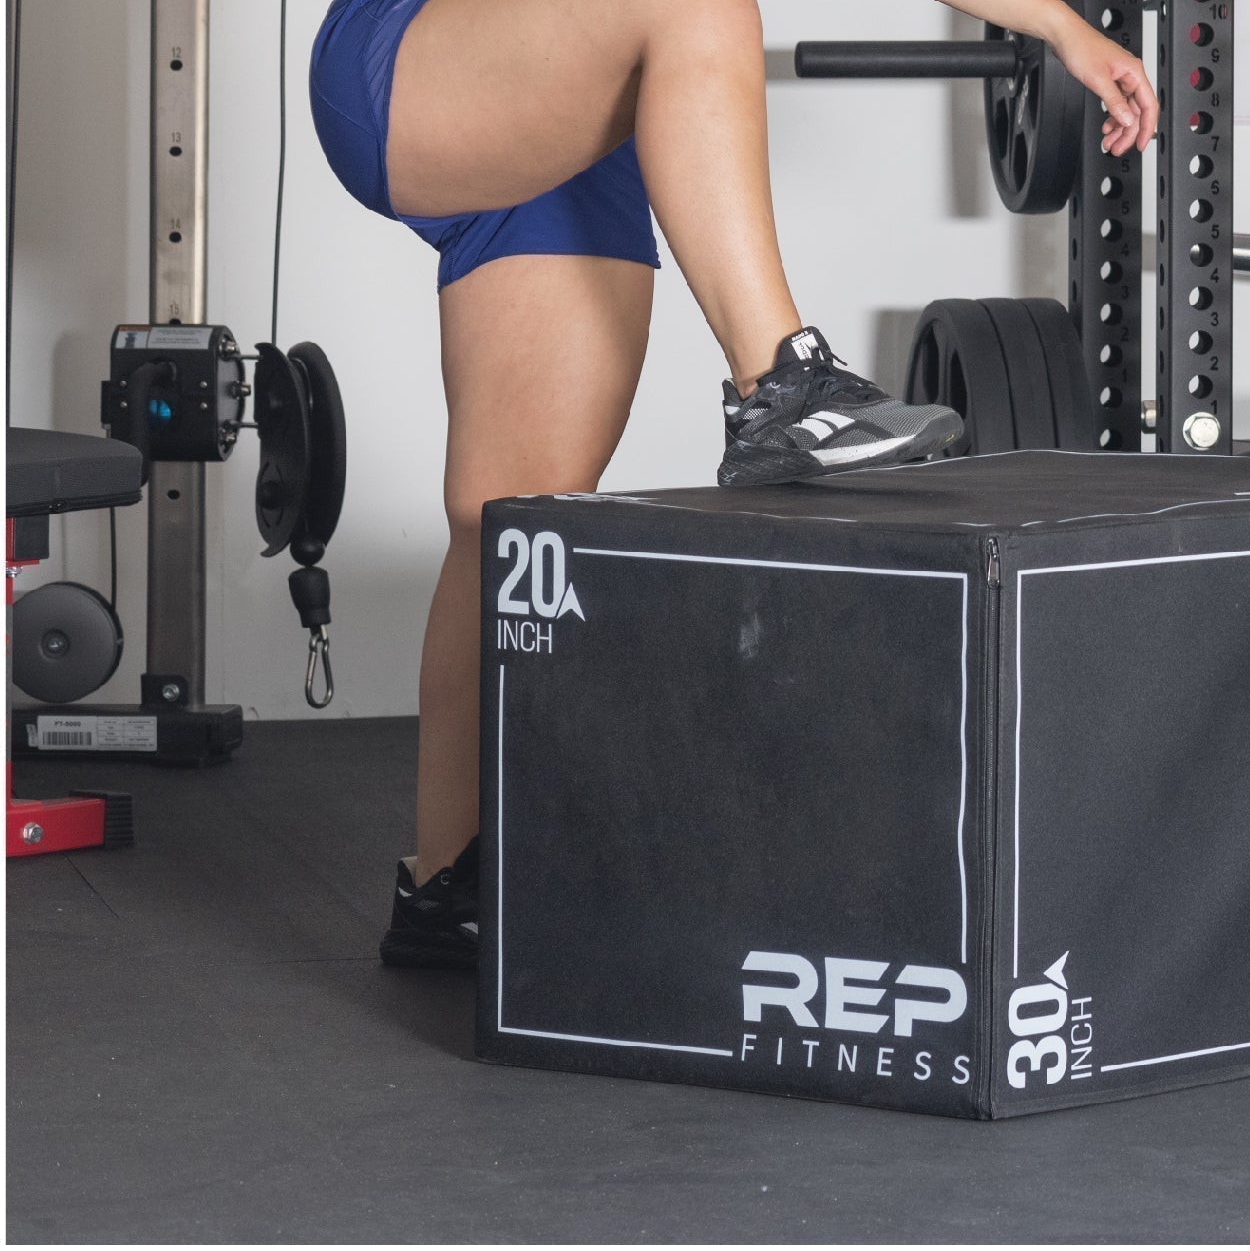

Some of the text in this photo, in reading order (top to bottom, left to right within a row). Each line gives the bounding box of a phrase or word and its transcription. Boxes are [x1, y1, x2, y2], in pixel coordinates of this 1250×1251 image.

[1210, 4, 1227, 19] 10
[172, 47, 181, 58] 12
[1211, 92, 1219, 107] 8
[172, 133, 181, 143] 13
[1211, 136, 1219, 151] 7
[171, 220, 181, 230] 14
[1211, 224, 1219, 239] 5
[1210, 268, 1219, 283] 4
[1211, 312, 1218, 327] 3
[1210, 356, 1218, 371] 2
[1211, 400, 1217, 414] 1
[498, 528, 565, 617] 20
[498, 619, 552, 653] INCH
[742, 950, 967, 1037] REP
[1007, 983, 1068, 1088] 30
[1070, 997, 1092, 1080] INCH
[741, 1034, 970, 1085] FITNESS
